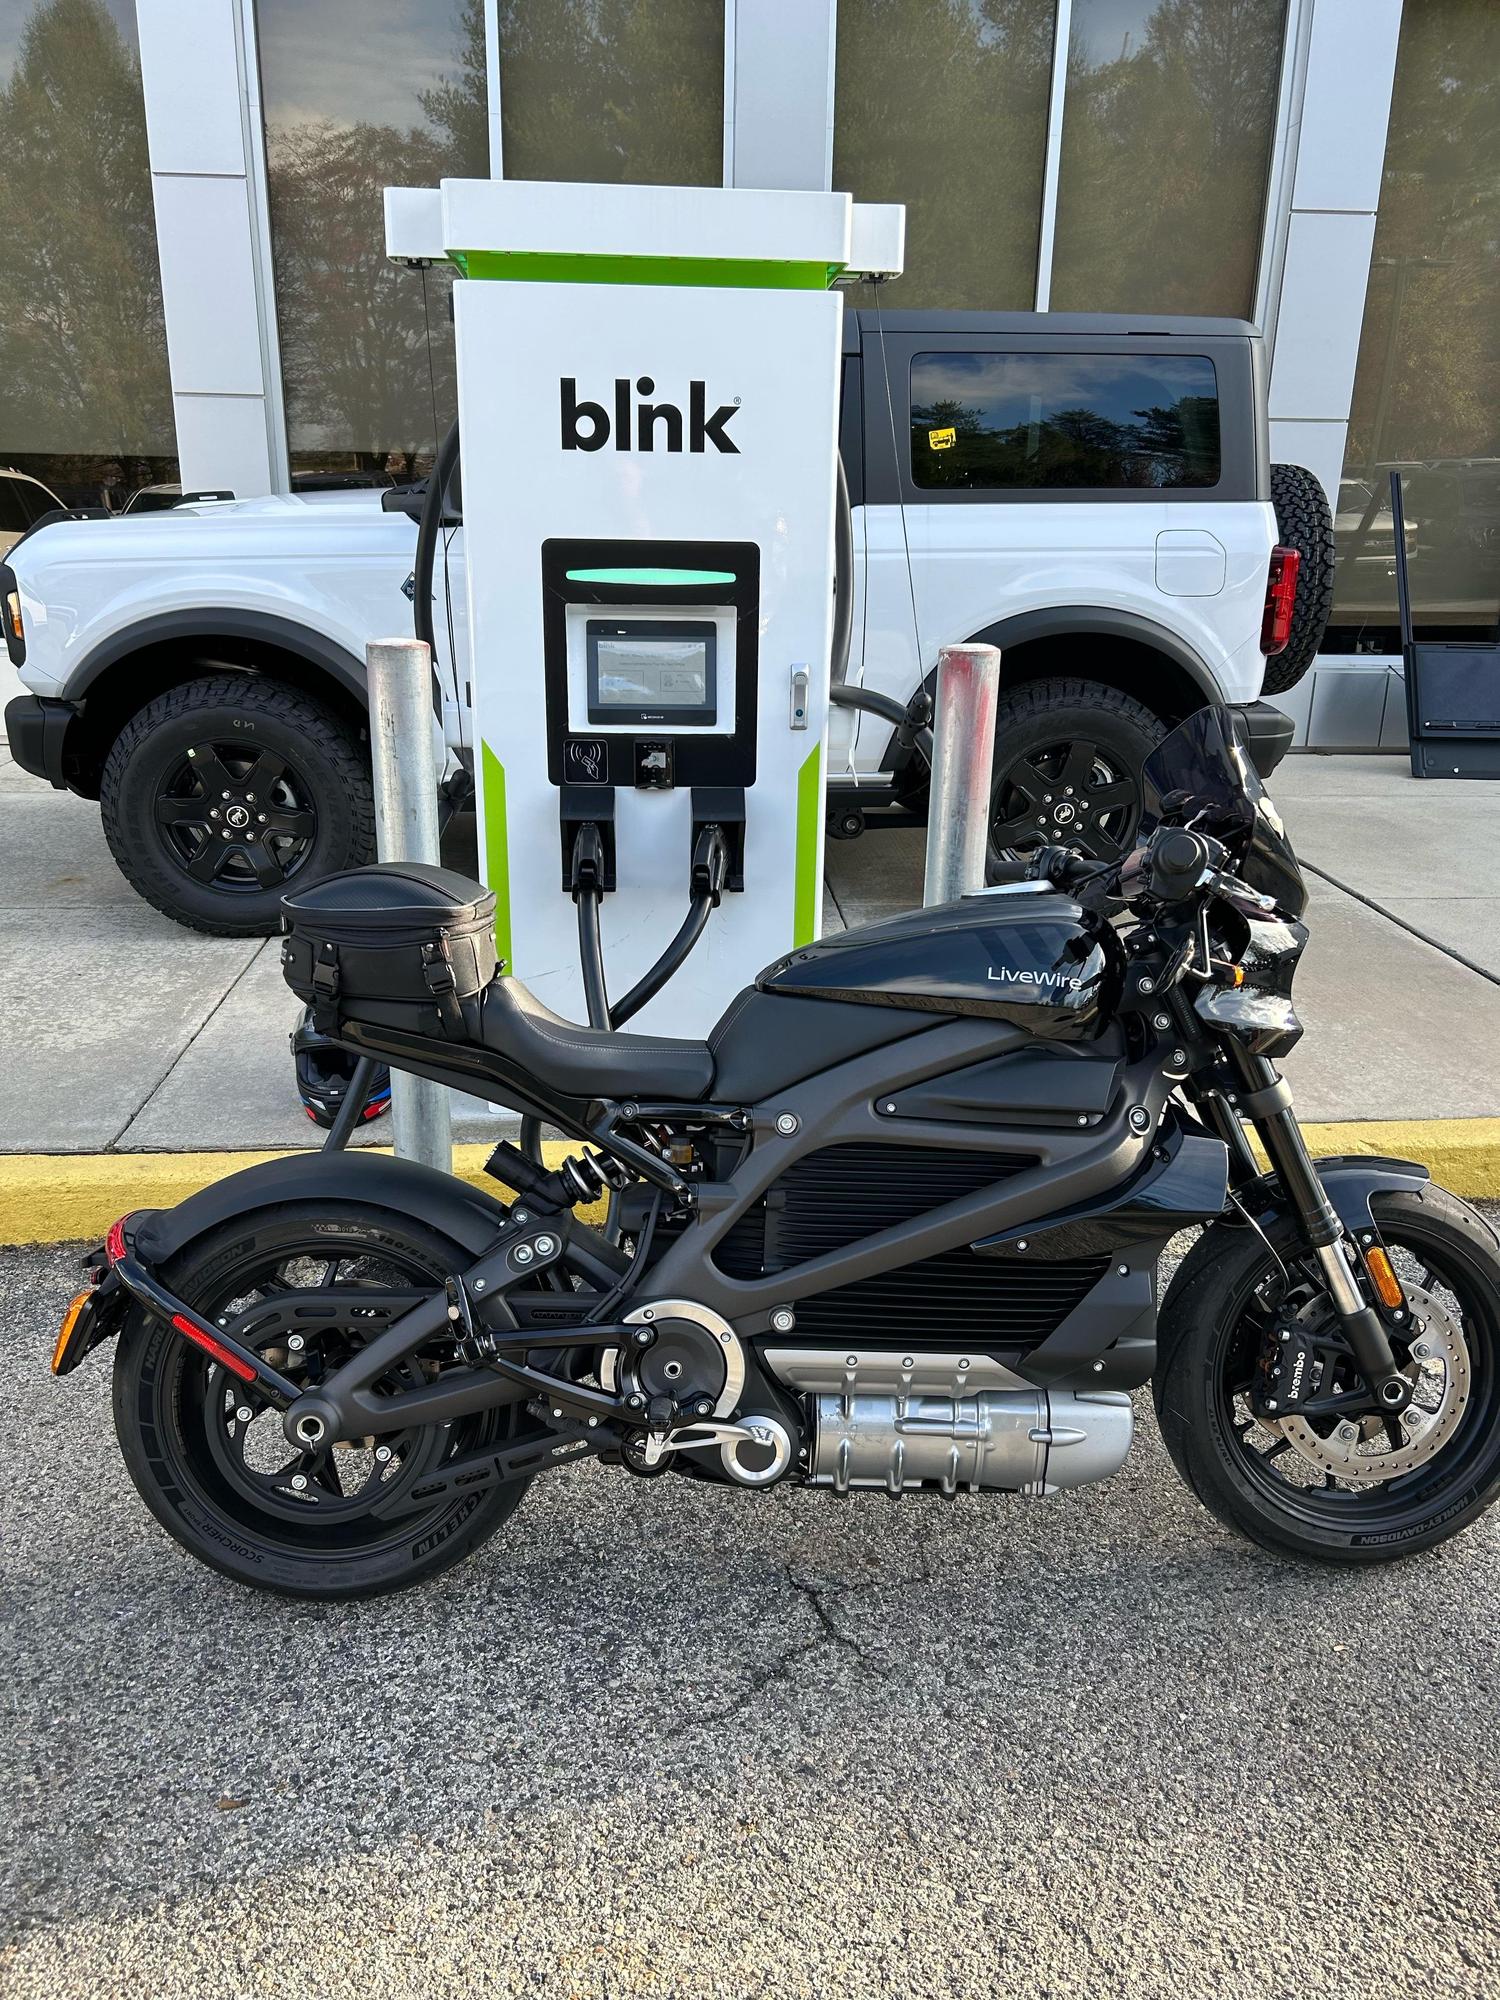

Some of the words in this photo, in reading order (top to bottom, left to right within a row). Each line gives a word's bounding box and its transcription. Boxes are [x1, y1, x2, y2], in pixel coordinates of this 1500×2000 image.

[560, 376, 741, 453] blink
[987, 966, 1082, 990] LiveWire
[1287, 1351, 1305, 1399] brembo
[201, 1523, 265, 1564] SCORCHER
[418, 1495, 480, 1555] CHELIN
[1360, 1496, 1469, 1545] HARLEY-DAVIDSON
